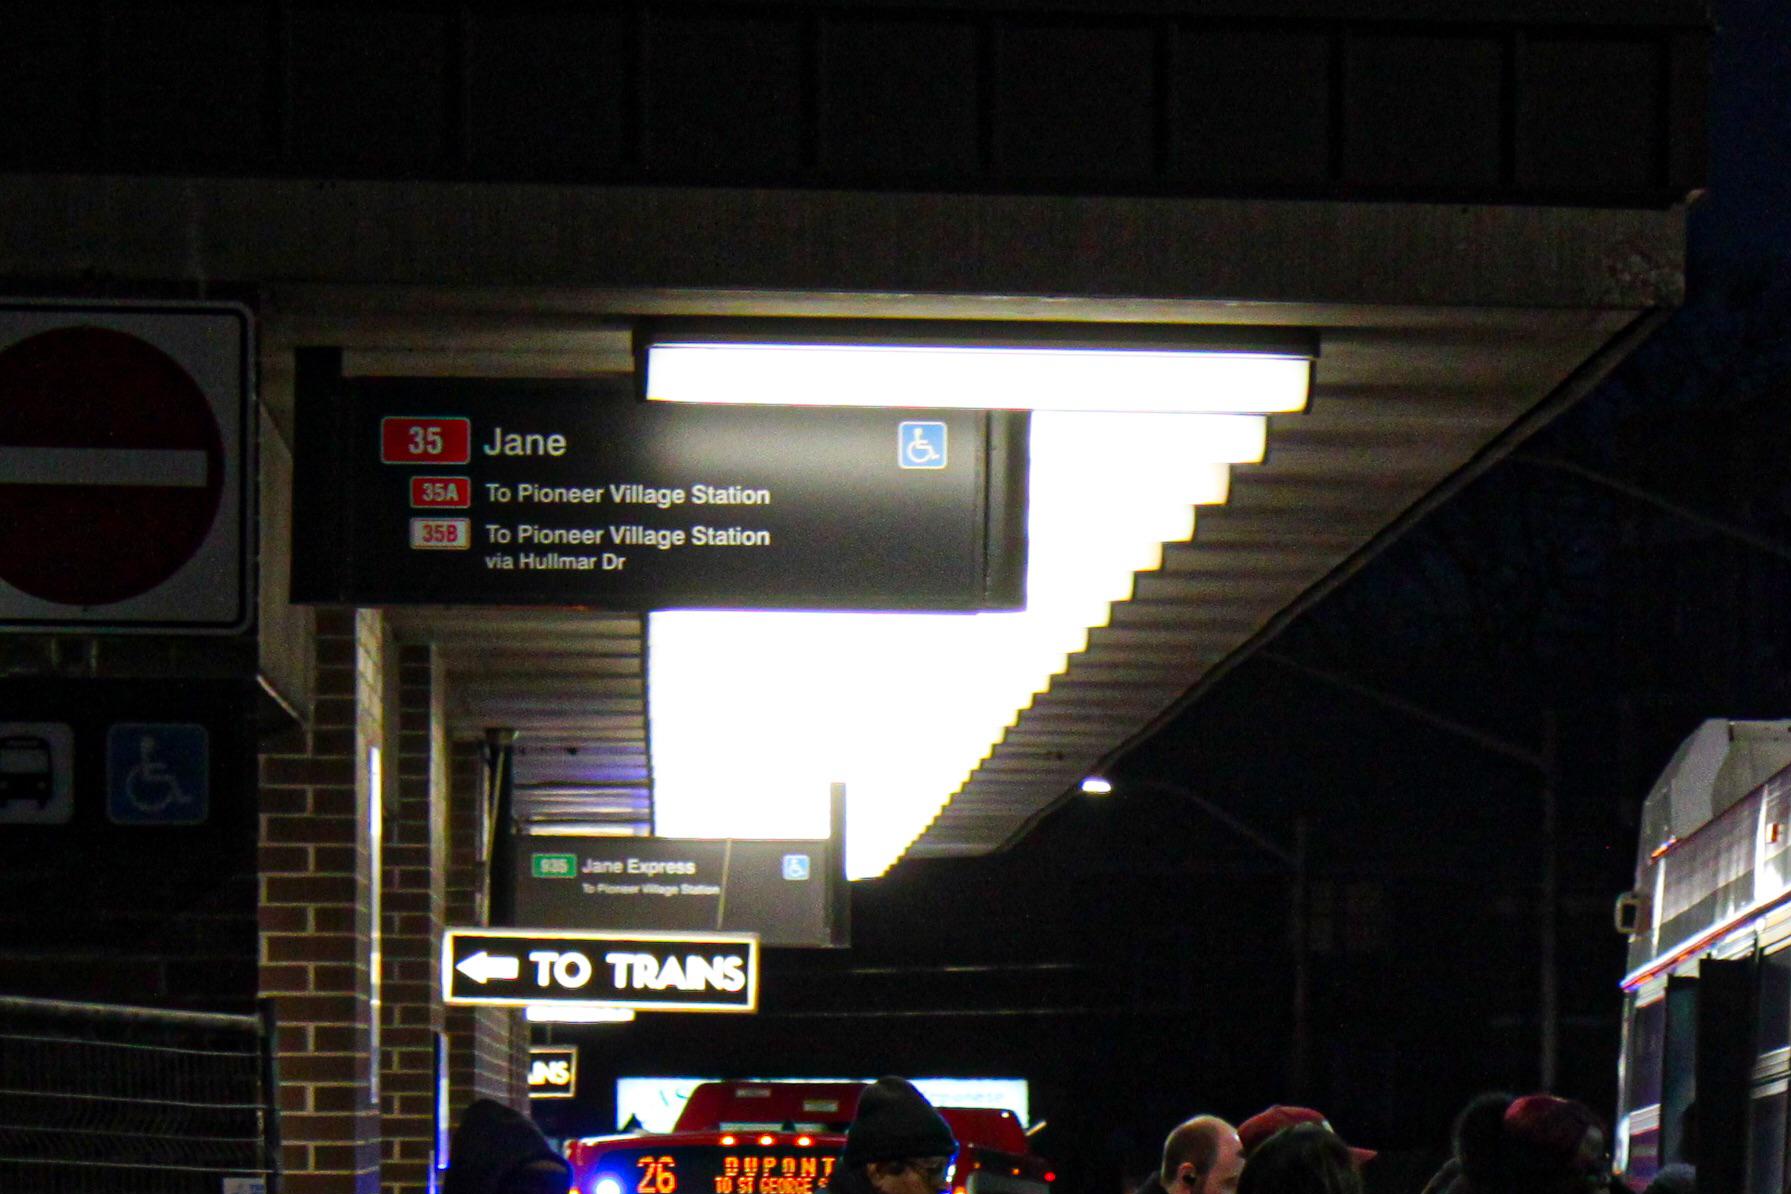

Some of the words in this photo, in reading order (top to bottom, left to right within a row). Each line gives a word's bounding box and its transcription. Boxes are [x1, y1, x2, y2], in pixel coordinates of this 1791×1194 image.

[407, 426, 444, 456] 35
[483, 428, 568, 457] Jane
[422, 483, 460, 502] 35A
[485, 484, 511, 503] To
[517, 483, 604, 503] Pioneer
[609, 484, 686, 509] Village
[690, 485, 771, 505] Station
[421, 523, 459, 544] 35B
[485, 525, 511, 544] To
[517, 524, 604, 545] Pioneer
[609, 525, 686, 550] Village
[690, 526, 771, 547] Station
[485, 554, 514, 570] via
[519, 553, 597, 571] Hullmar
[602, 553, 627, 571] Dr
[581, 858, 624, 875] Jane
[626, 857, 697, 877] Express
[680, 883, 721, 896] Station
[528, 950, 593, 989] TO
[604, 951, 746, 993] TRAINS
[636, 1154, 678, 1194] 26
[723, 1155, 837, 1178] DUPONT
[713, 1176, 734, 1194] TO
[737, 1176, 756, 1194] ST
